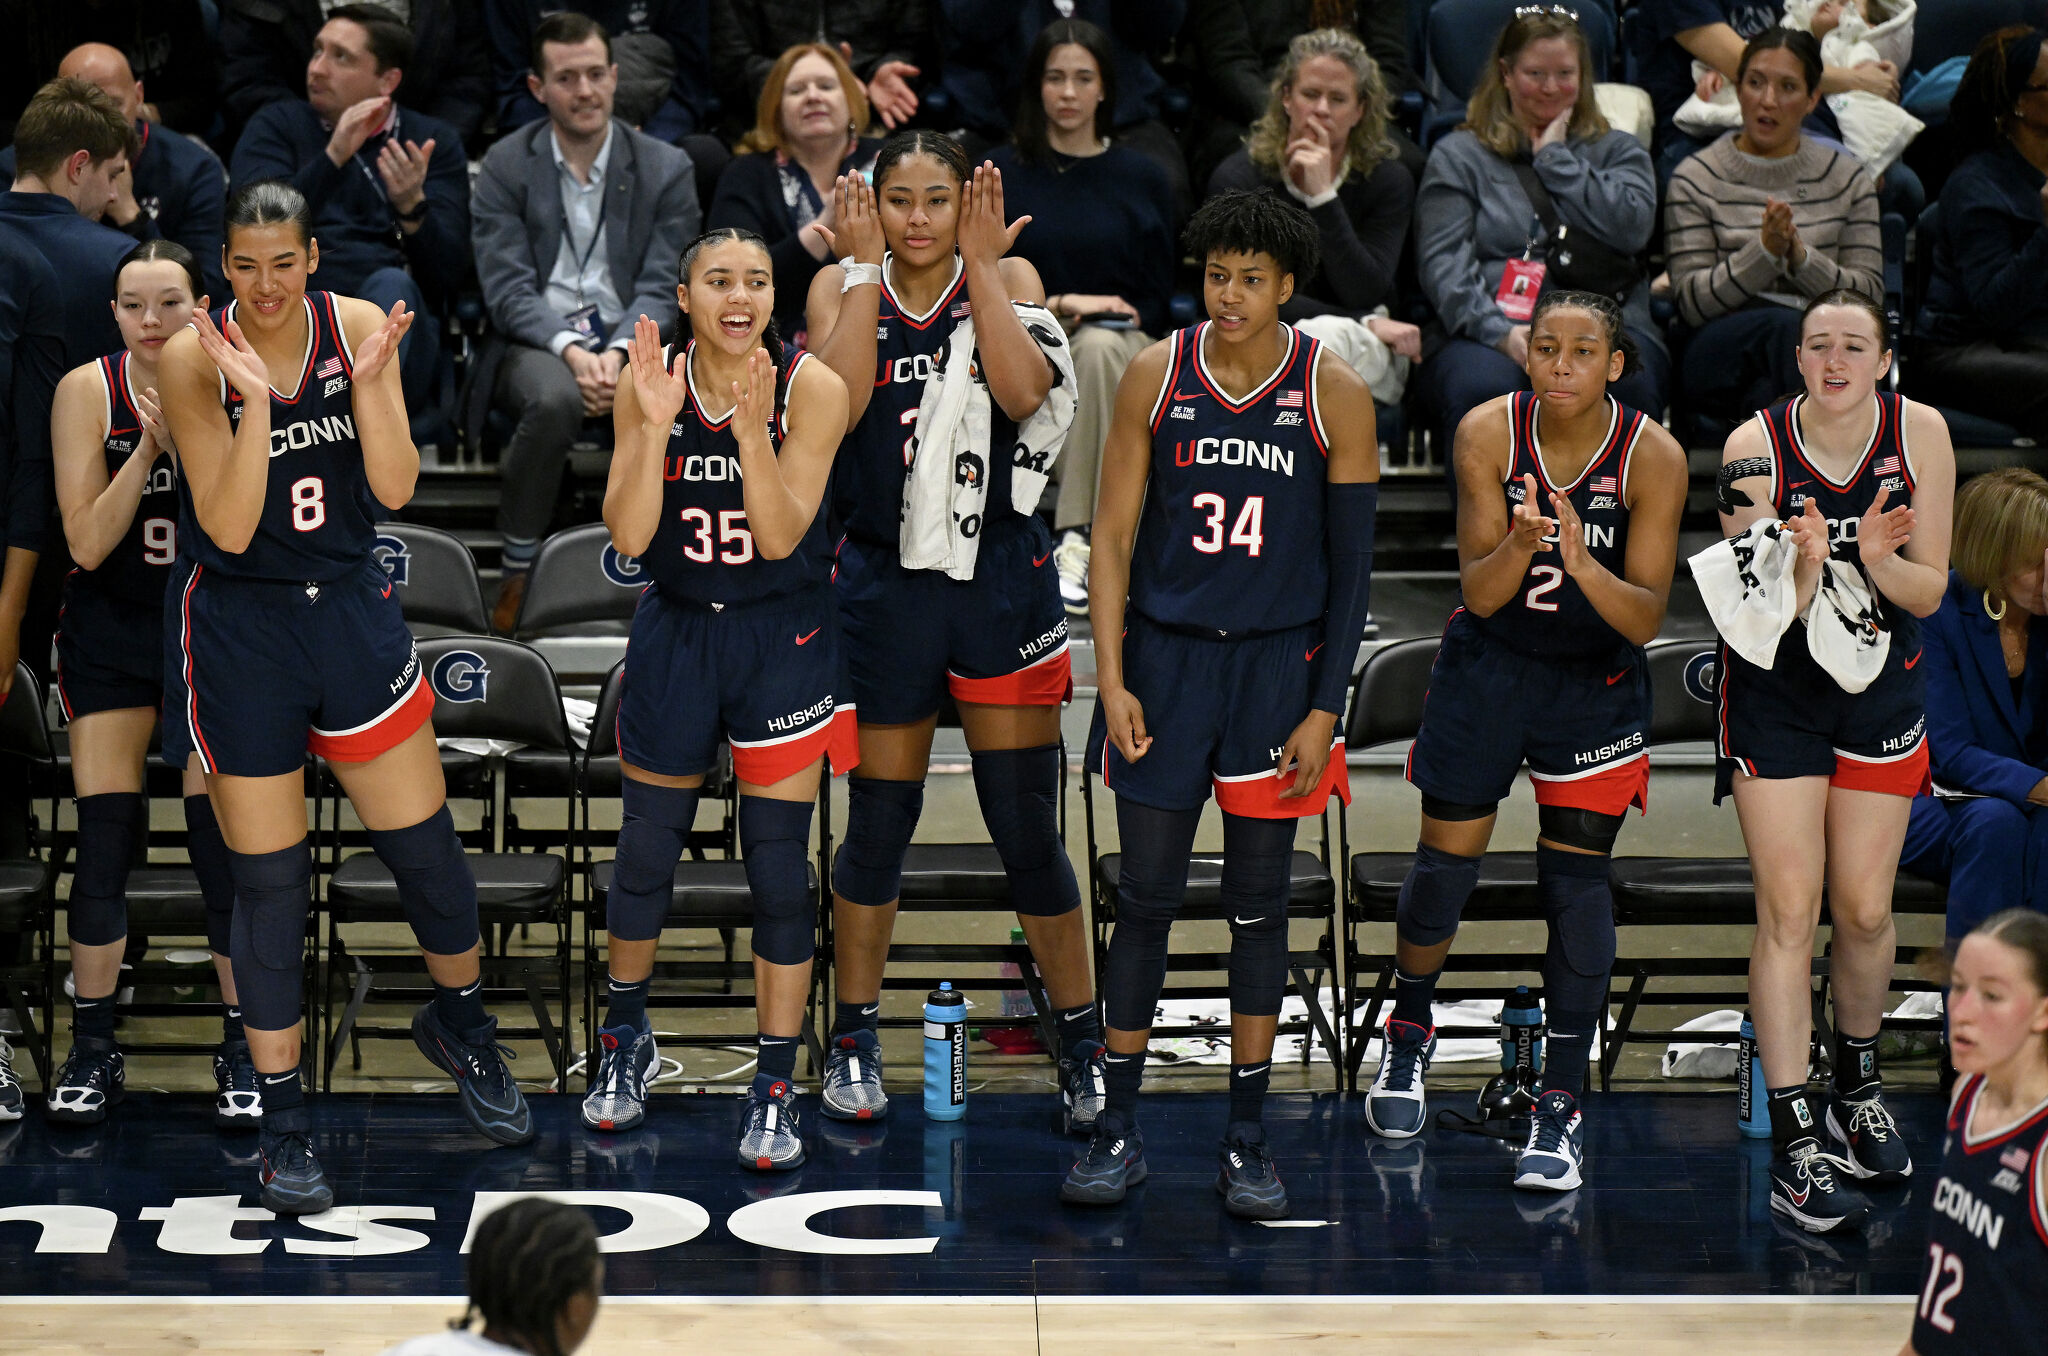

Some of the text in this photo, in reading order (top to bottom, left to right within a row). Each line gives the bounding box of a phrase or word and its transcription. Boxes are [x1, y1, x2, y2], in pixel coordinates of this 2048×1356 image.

[324, 380, 348, 395] EAST
[325, 376, 343, 388] BIG
[874, 353, 932, 387] UCO
[1170, 411, 1195, 421] CHANGE
[1173, 405, 1195, 414] BE THE
[1275, 417, 1304, 425] EAST
[107, 445, 132, 453] CHANGE
[119, 440, 131, 448] THE
[269, 414, 355, 458] CONN
[663, 455, 743, 482] UCON
[1175, 437, 1294, 477] UCONN
[1881, 477, 1899, 486] BIG
[291, 475, 326, 532] 8
[143, 517, 177, 565] 9
[680, 507, 754, 565] 35
[1192, 491, 1264, 557] 34
[1525, 564, 1564, 612] 2
[1019, 616, 1068, 660] HUSKIES
[431, 650, 491, 703] G
[767, 694, 833, 732] HUSKIES
[1575, 731, 1643, 765] HUSKIES
[952, 1023, 964, 1103] POWERADE
[1739, 1039, 1751, 1119] POWERADE
[1933, 1176, 2004, 1251] CONN
[1920, 1241, 1964, 1334] 12
